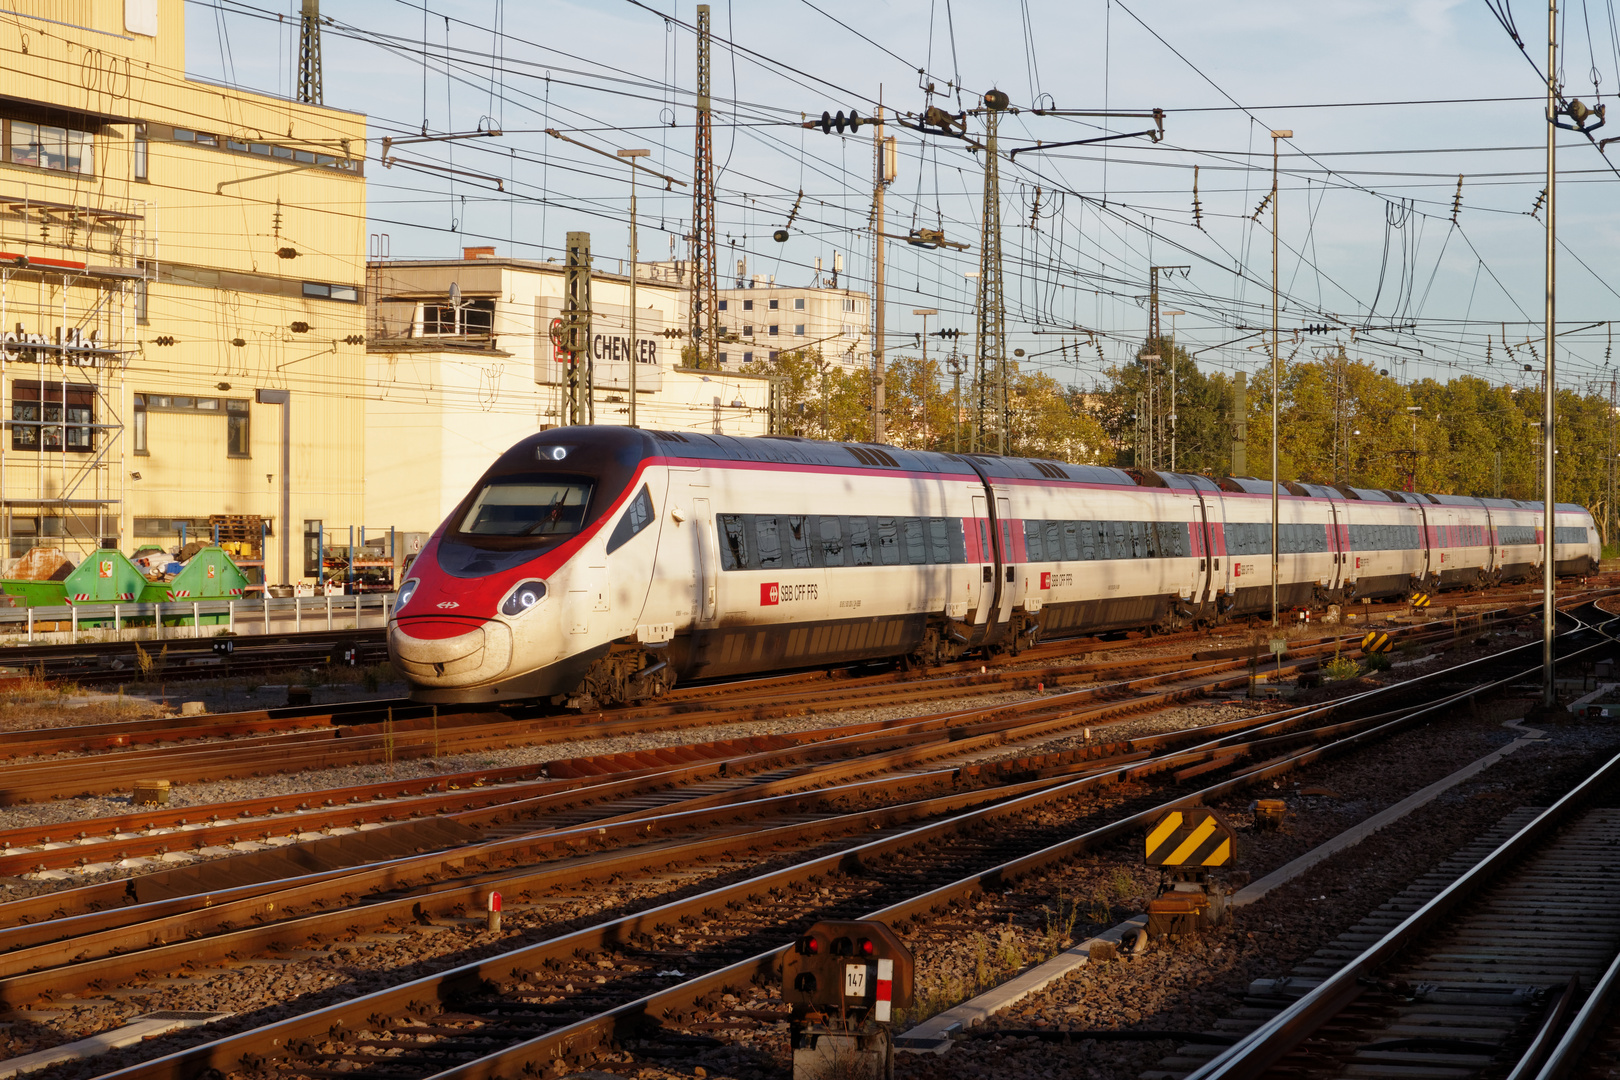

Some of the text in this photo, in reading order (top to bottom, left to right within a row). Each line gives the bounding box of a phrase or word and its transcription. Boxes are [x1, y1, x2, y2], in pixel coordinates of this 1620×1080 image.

[586, 334, 657, 364] CHENKER
[780, 583, 818, 602] SBB CFF FFS
[848, 973, 864, 987] 147
